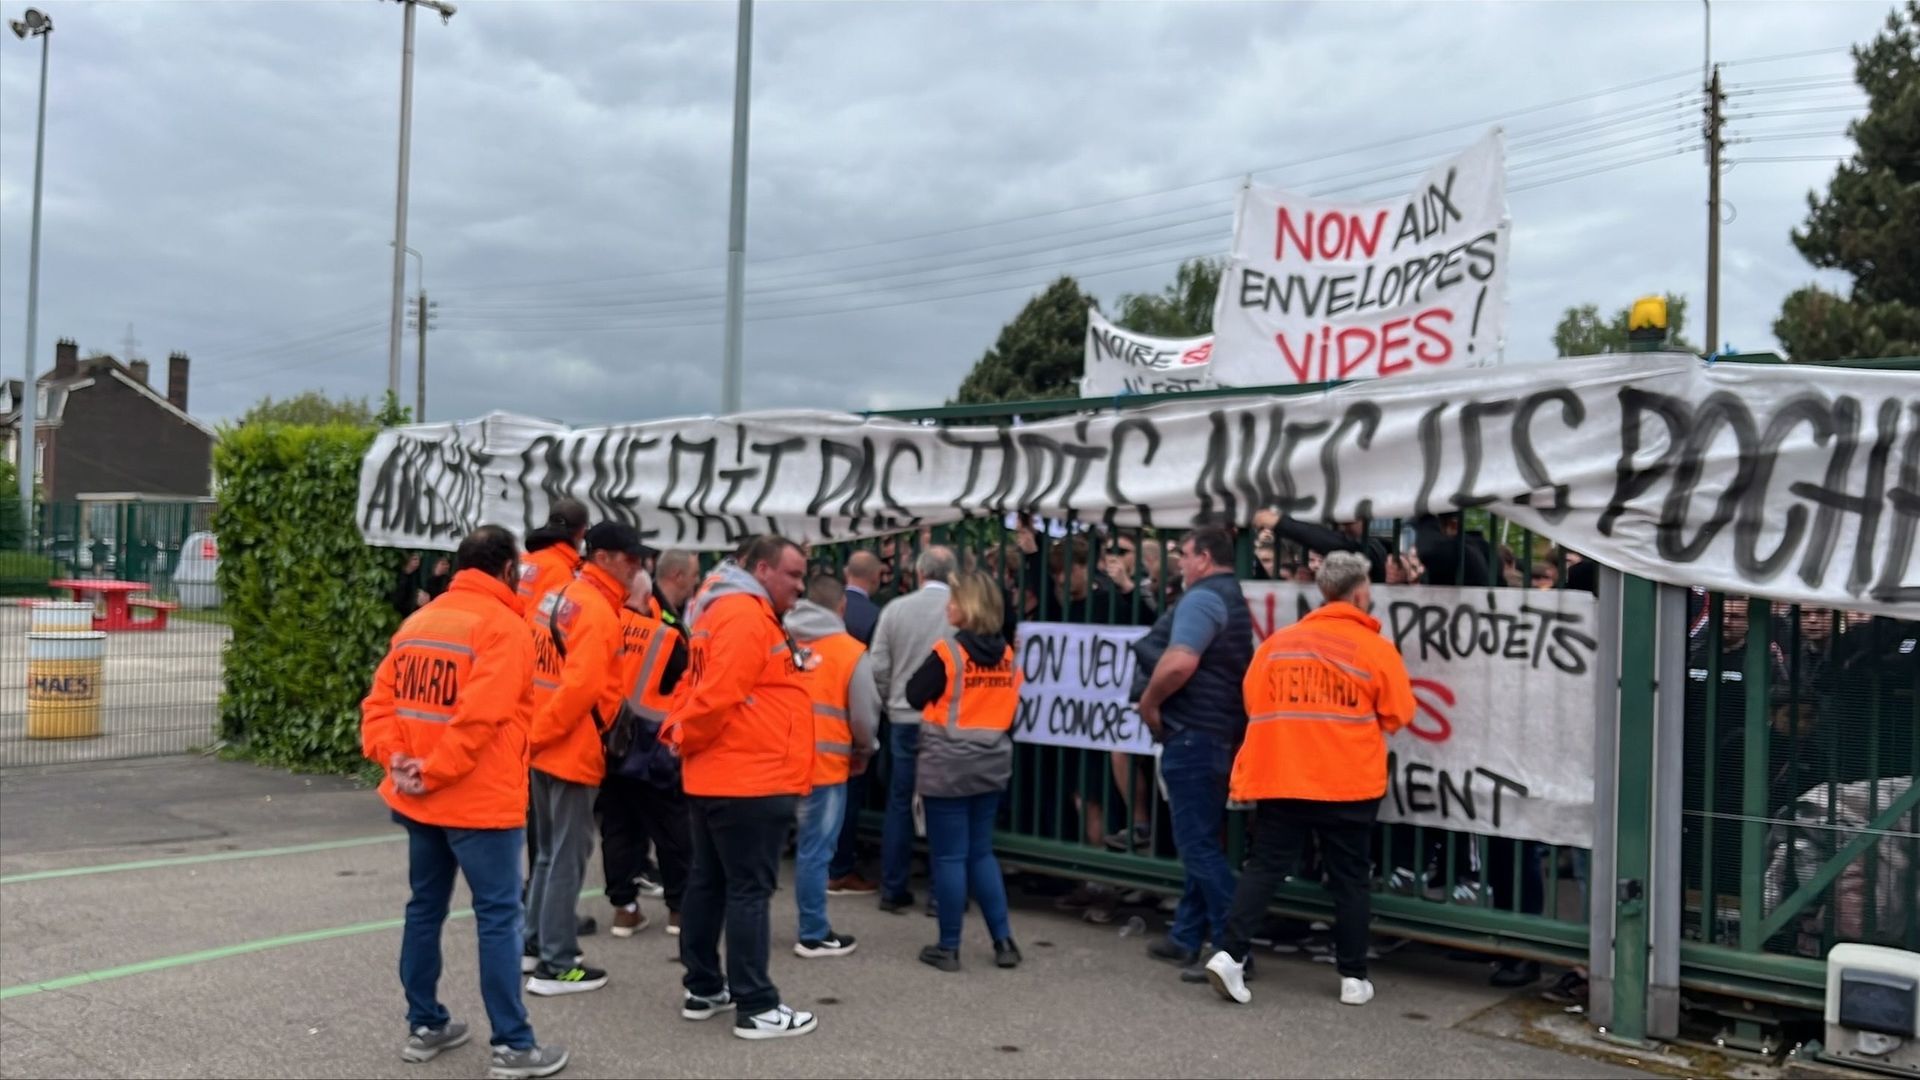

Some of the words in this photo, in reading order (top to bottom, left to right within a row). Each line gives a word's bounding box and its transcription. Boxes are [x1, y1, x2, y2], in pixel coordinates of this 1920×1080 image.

[1274, 207, 1388, 261] NON
[1392, 167, 1461, 251] AUX
[1239, 232, 1497, 316] ENVELOPPES
[1092, 326, 1178, 369] NOTRE
[1196, 402, 1381, 527] AVEC
[1415, 387, 1586, 524] LES
[1024, 635, 1067, 684] ON
[1079, 634, 1136, 688] VEU
[1268, 666, 1359, 707] STEWARD
